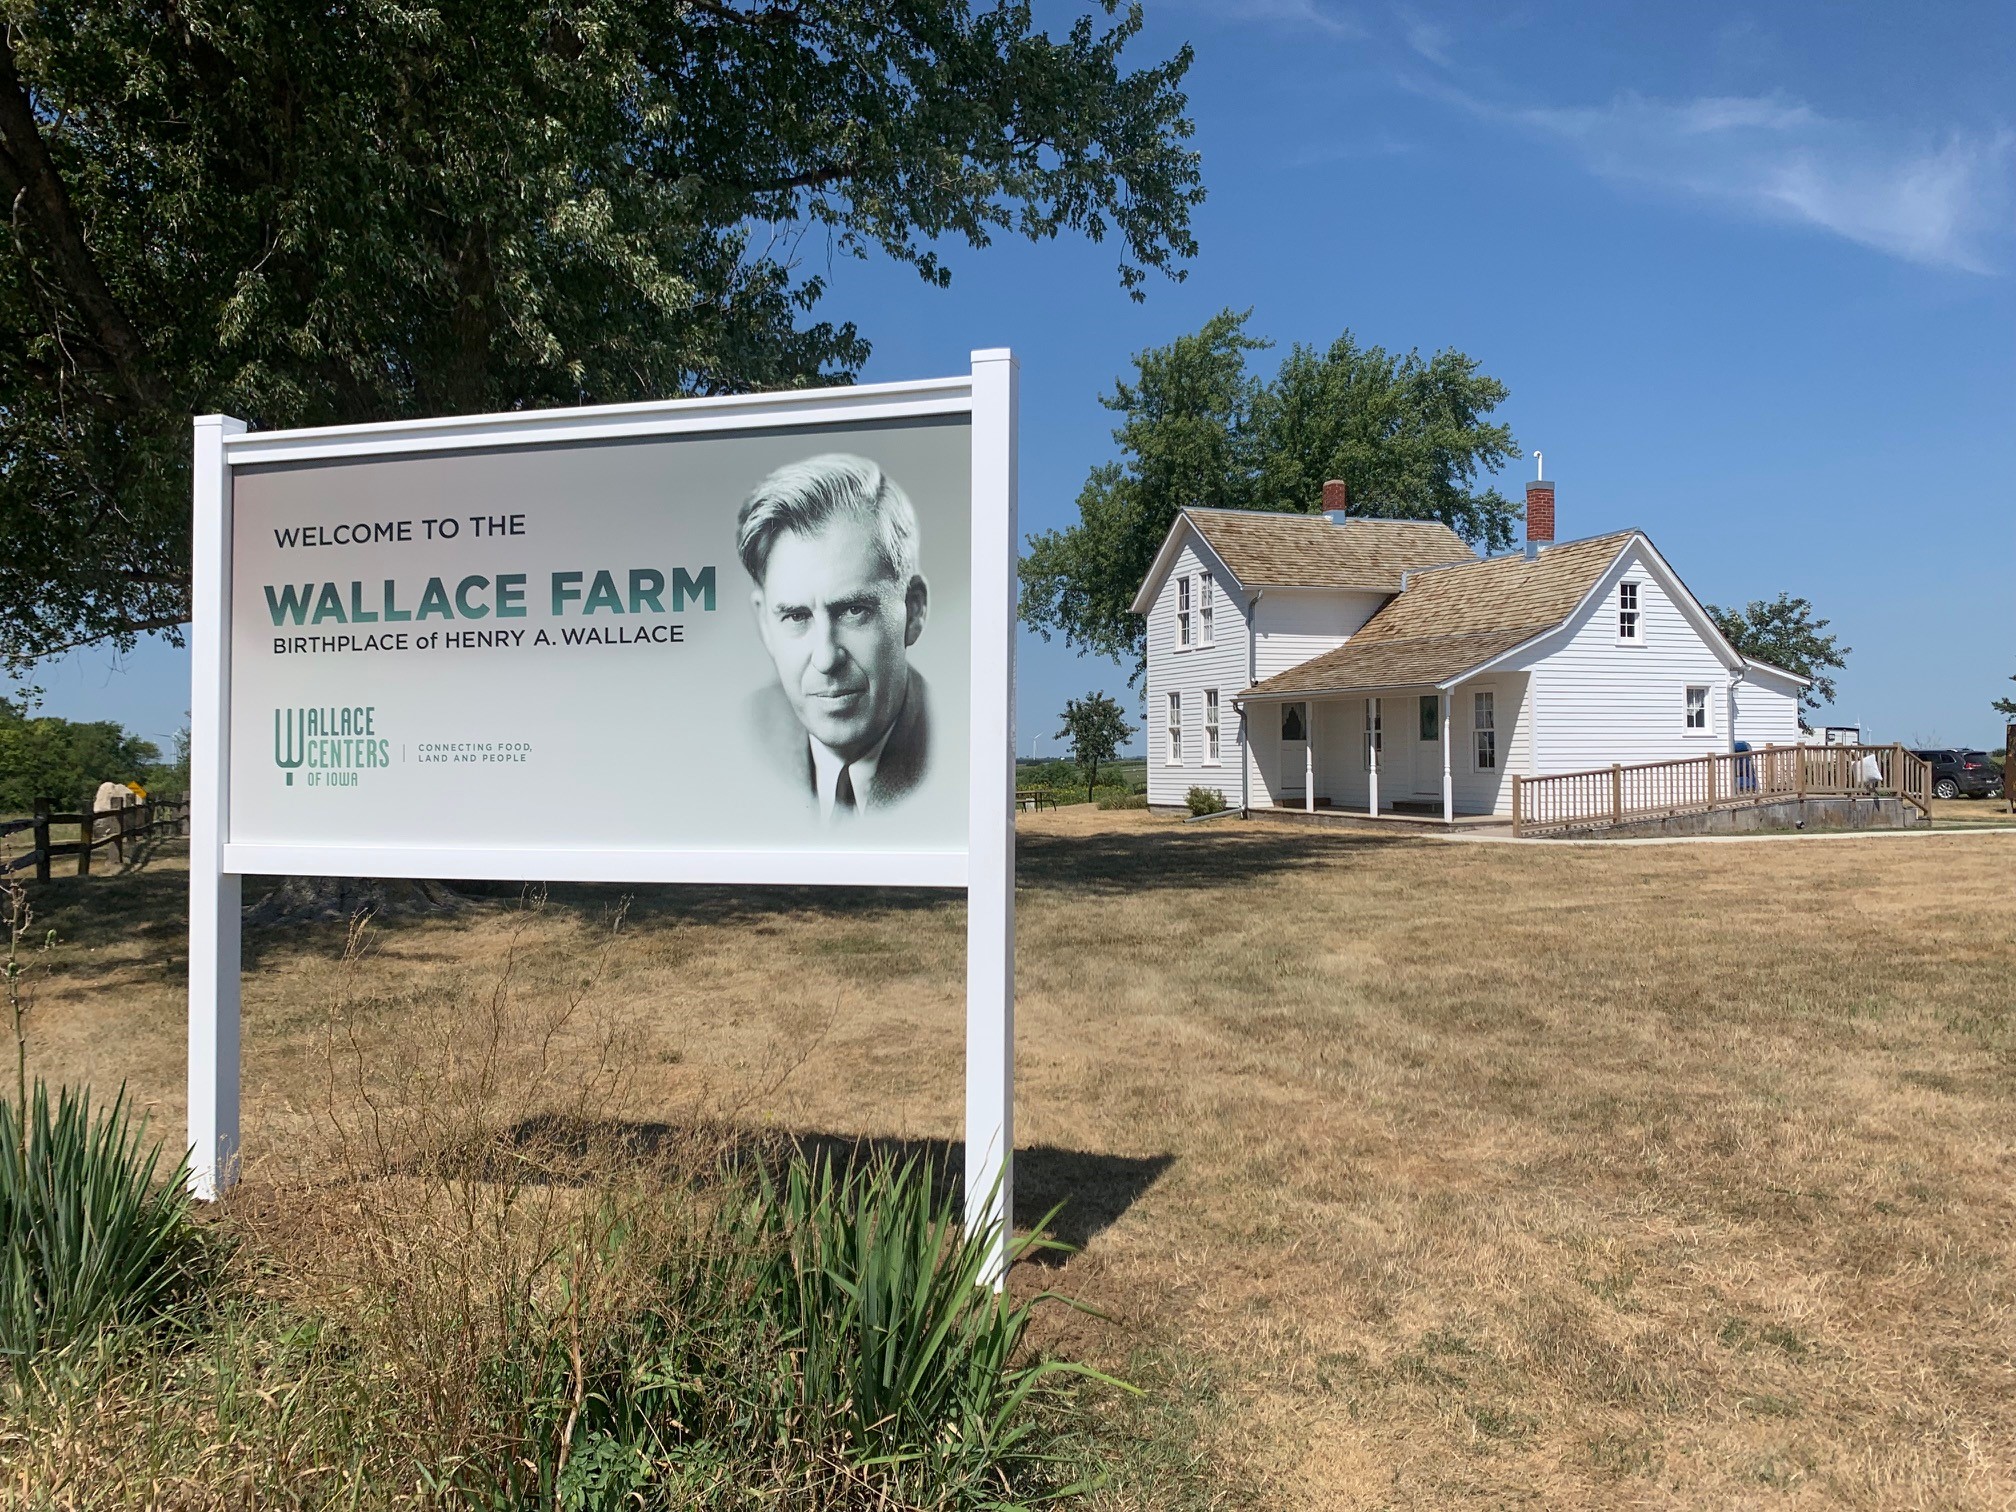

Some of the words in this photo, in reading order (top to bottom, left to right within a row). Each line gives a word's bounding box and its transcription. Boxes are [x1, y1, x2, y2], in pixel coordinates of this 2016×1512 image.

[273, 520, 413, 549] WELCOME
[422, 517, 460, 540] TO
[469, 513, 526, 538] THE
[263, 573, 527, 627] WALLACE
[551, 566, 717, 616] FARM
[273, 633, 409, 655] BIRTHPLACE
[415, 631, 439, 651] of
[445, 629, 526, 649] HENRY
[533, 628, 557, 647] A.
[560, 624, 685, 646] WALLACE
[274, 706, 375, 769] WALLACE
[418, 743, 493, 753] CONNECTING
[497, 742, 533, 753] FOOD,
[307, 738, 390, 769] CENTERS
[418, 754, 448, 763] LAND
[453, 753, 477, 763] AND
[482, 753, 527, 763] PEOPLE
[307, 772, 322, 787] OF
[326, 772, 358, 787] IOWA
